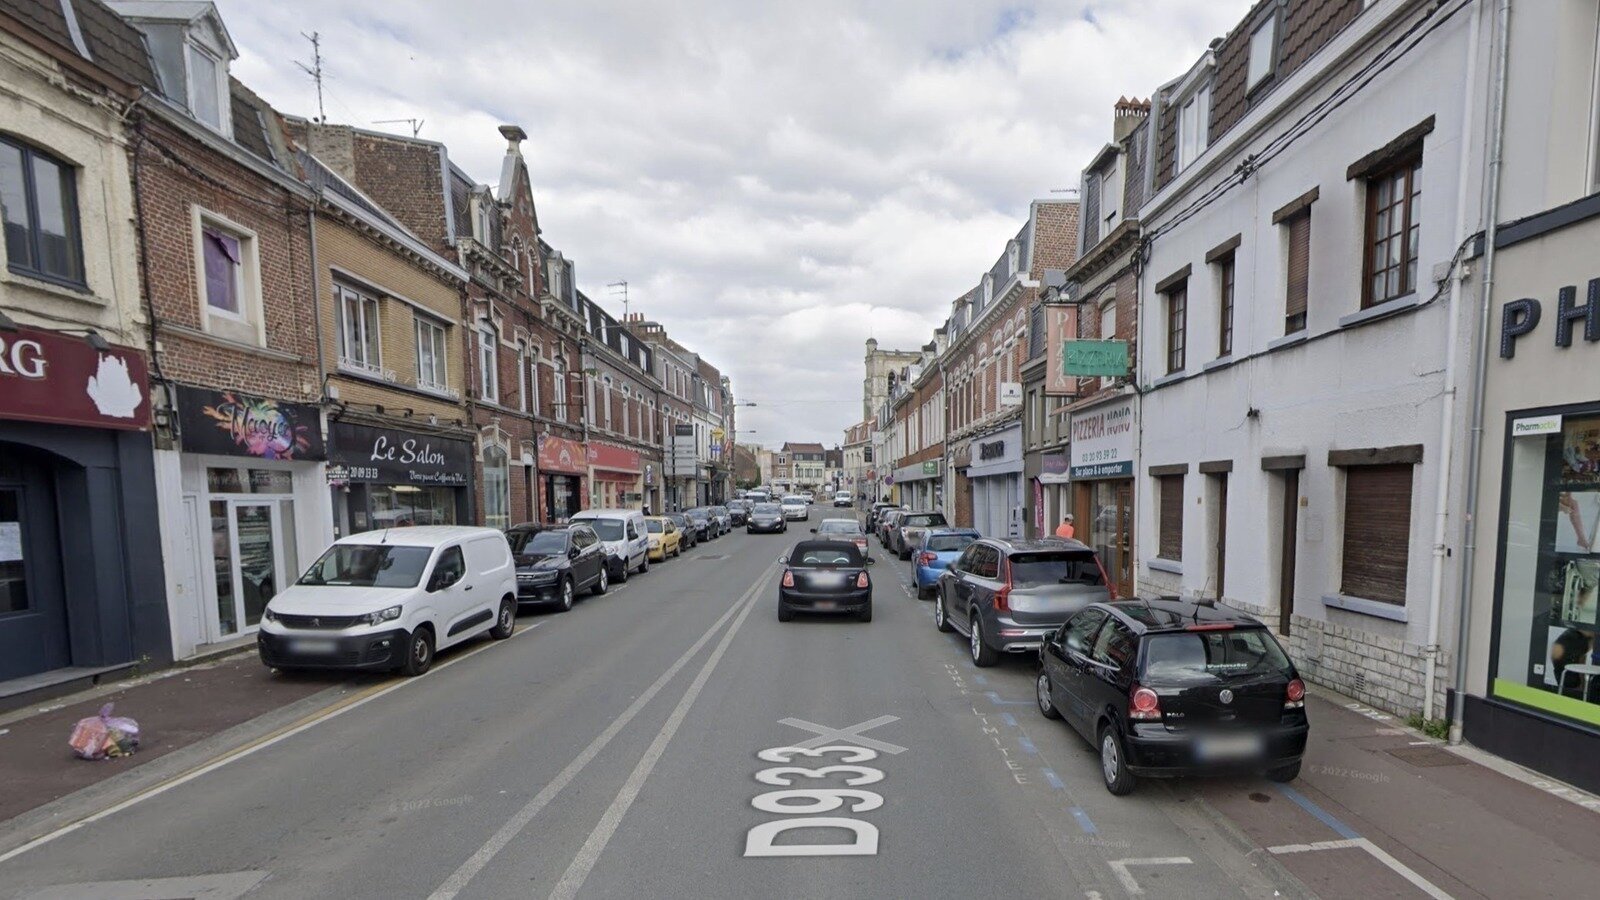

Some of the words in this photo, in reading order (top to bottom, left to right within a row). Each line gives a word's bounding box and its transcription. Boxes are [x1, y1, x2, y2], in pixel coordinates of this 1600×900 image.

[1500, 277, 1600, 359] PH
[1067, 350, 1125, 368] PIZZERIA
[1073, 413, 1105, 442] PIZZERIA
[1515, 419, 1557, 432] Pharmactiv
[371, 436, 396, 460] Le
[400, 439, 445, 465] Salon
[350, 466, 357, 478] 20
[365, 468, 371, 478] 13
[372, 468, 378, 479] 13
[1082, 467, 1093, 477] place
[1101, 464, 1123, 475] emporter
